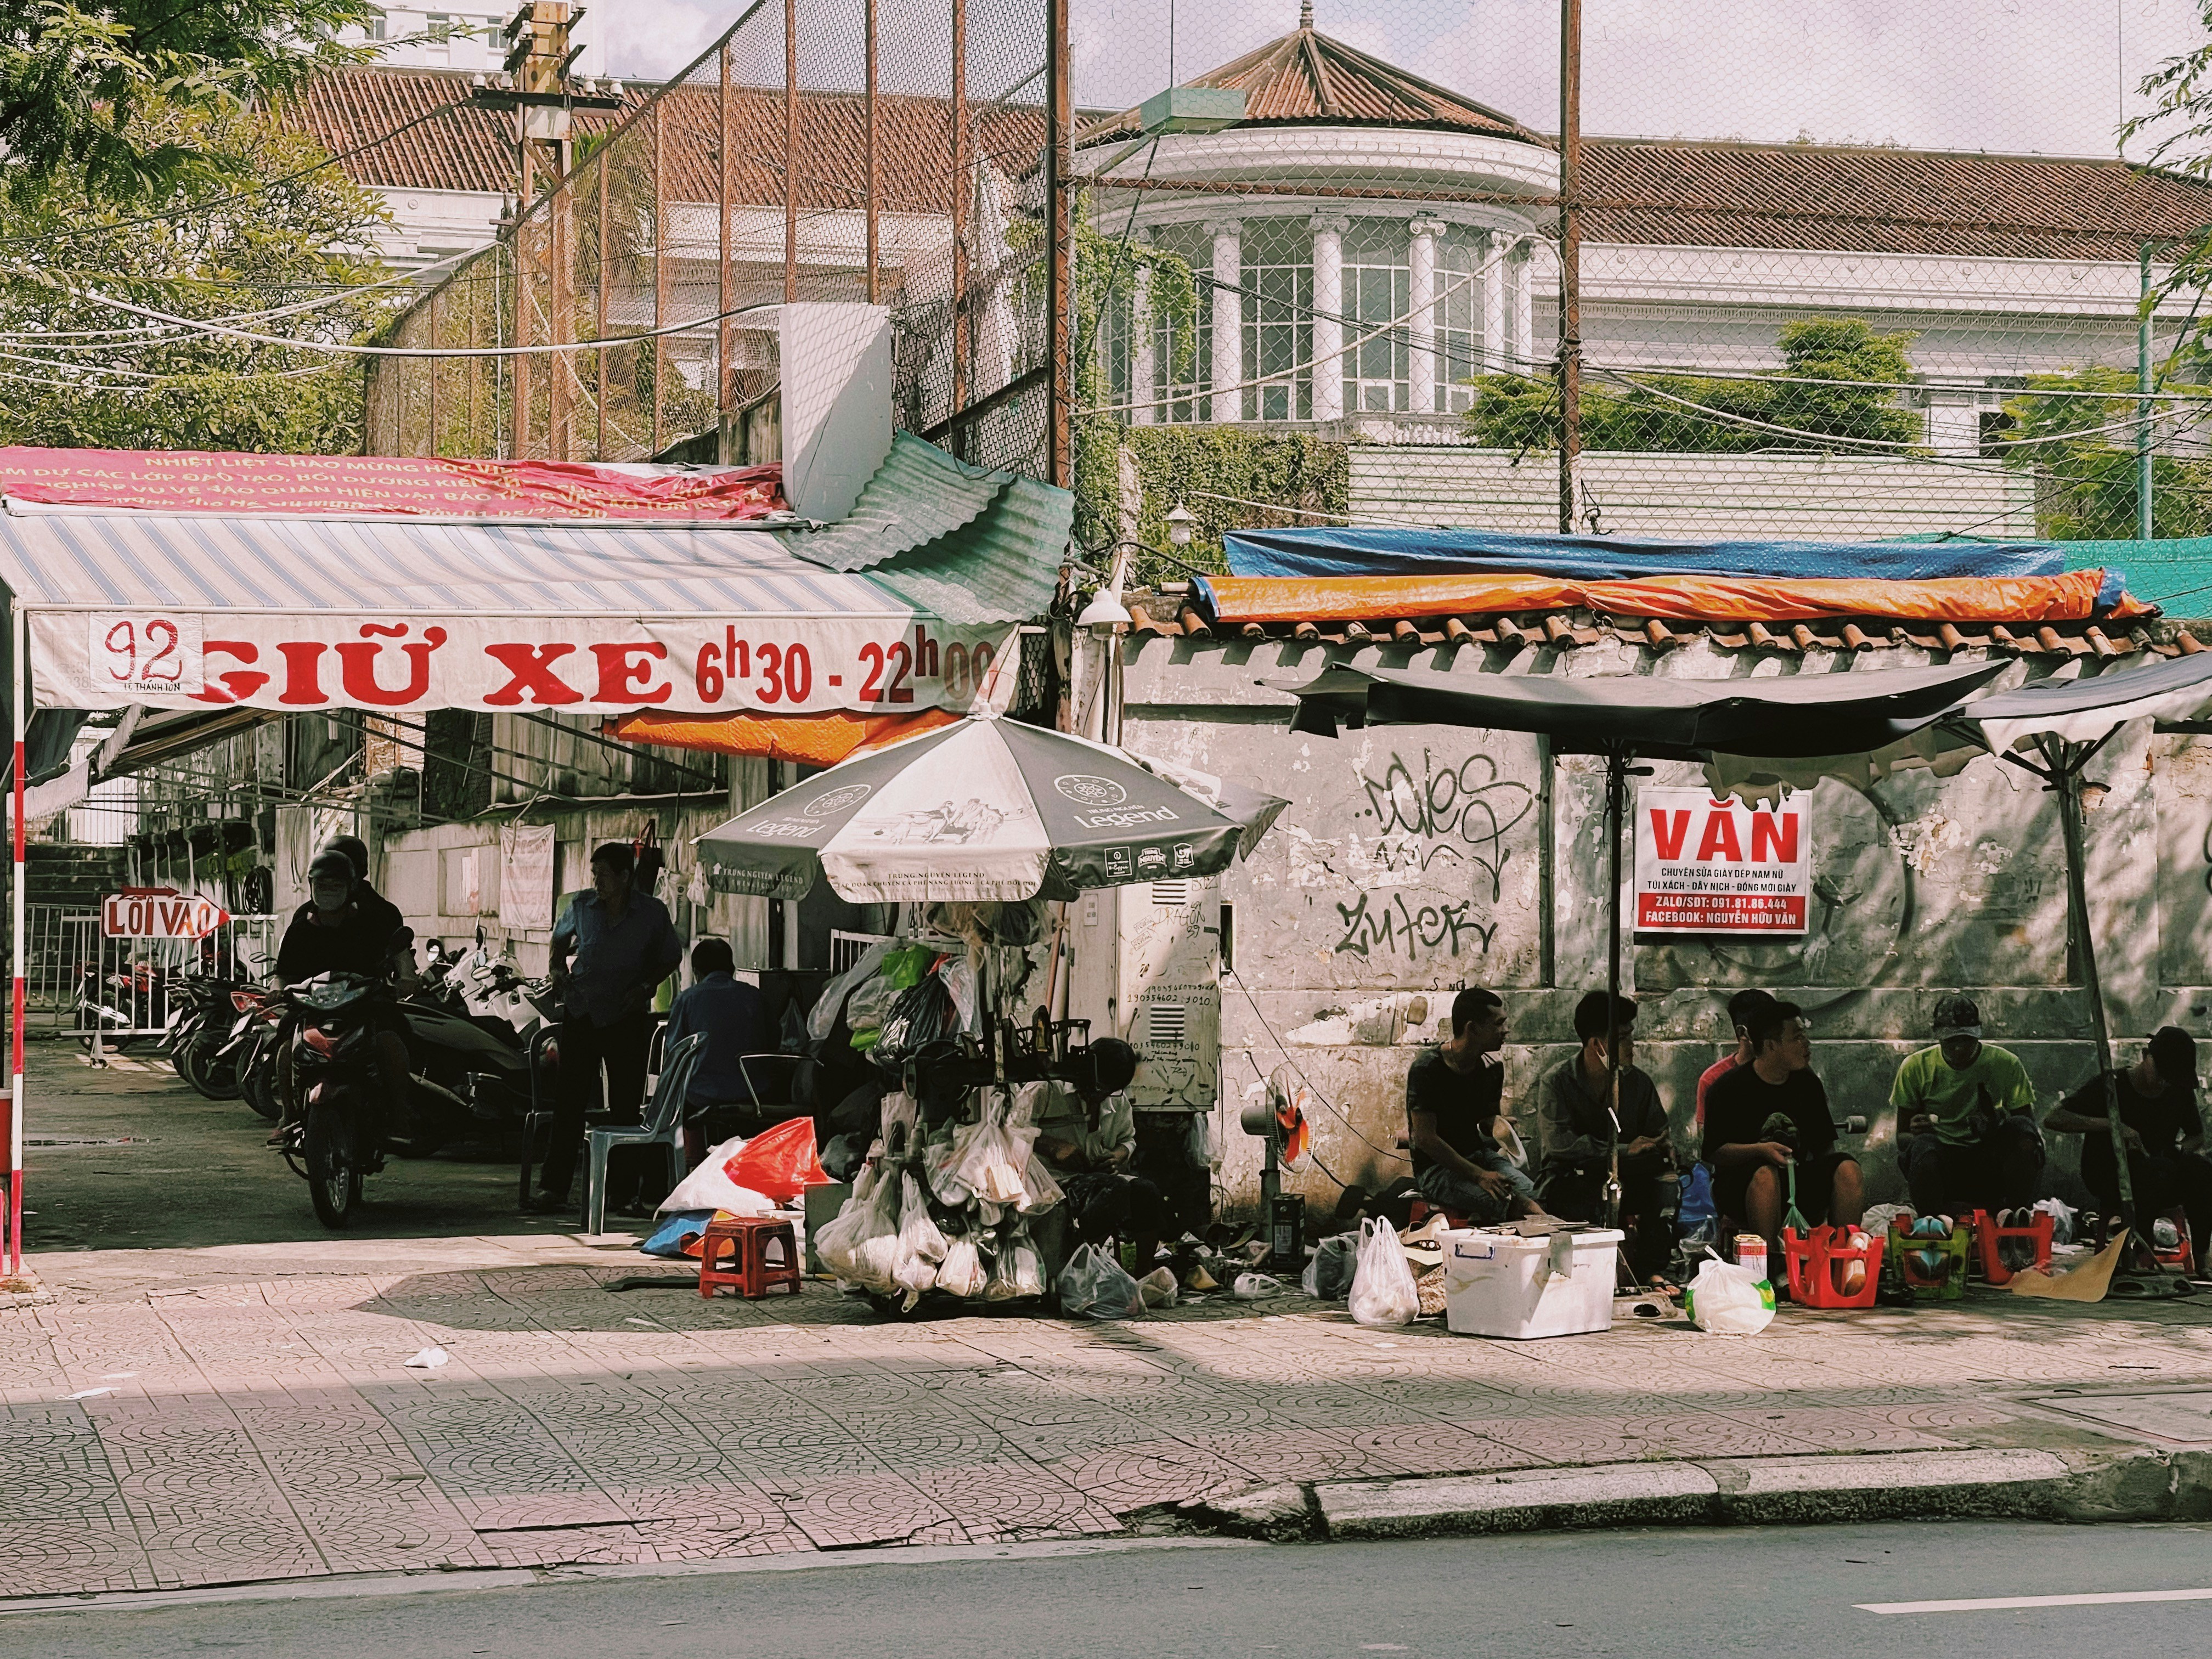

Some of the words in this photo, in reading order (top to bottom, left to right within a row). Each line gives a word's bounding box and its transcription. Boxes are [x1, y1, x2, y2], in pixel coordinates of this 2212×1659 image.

[105, 619, 183, 681] 92
[187, 623, 448, 706] GIỮ
[483, 641, 673, 706] XE
[1074, 805, 1180, 829] Legend
[746, 820, 827, 838] Legend
[1649, 799, 1799, 864] VĂN
[1661, 867, 1695, 877] CHUYÊN
[1696, 866, 1712, 877] SỬA
[1714, 867, 1733, 878] GIÀY
[1735, 868, 1751, 878] DÉP
[1752, 870, 1770, 879] NAM
[1772, 869, 1784, 879] NỮ
[1647, 880, 1661, 889] TÚI
[1662, 880, 1685, 890] XÁCH
[1692, 881, 1708, 890] DÂY
[1710, 882, 1730, 892] NỊCH
[1737, 882, 1759, 891] ĐÓNG
[1778, 882, 1797, 893] GIÀY
[1712, 897, 1787, 910] 091.81.86.444
[1646, 911, 1704, 923] FACEBOOK:
[1706, 909, 1750, 924] NGUYỄN
[1751, 911, 1773, 924] HỮU
[1775, 911, 1797, 924] VĂN
